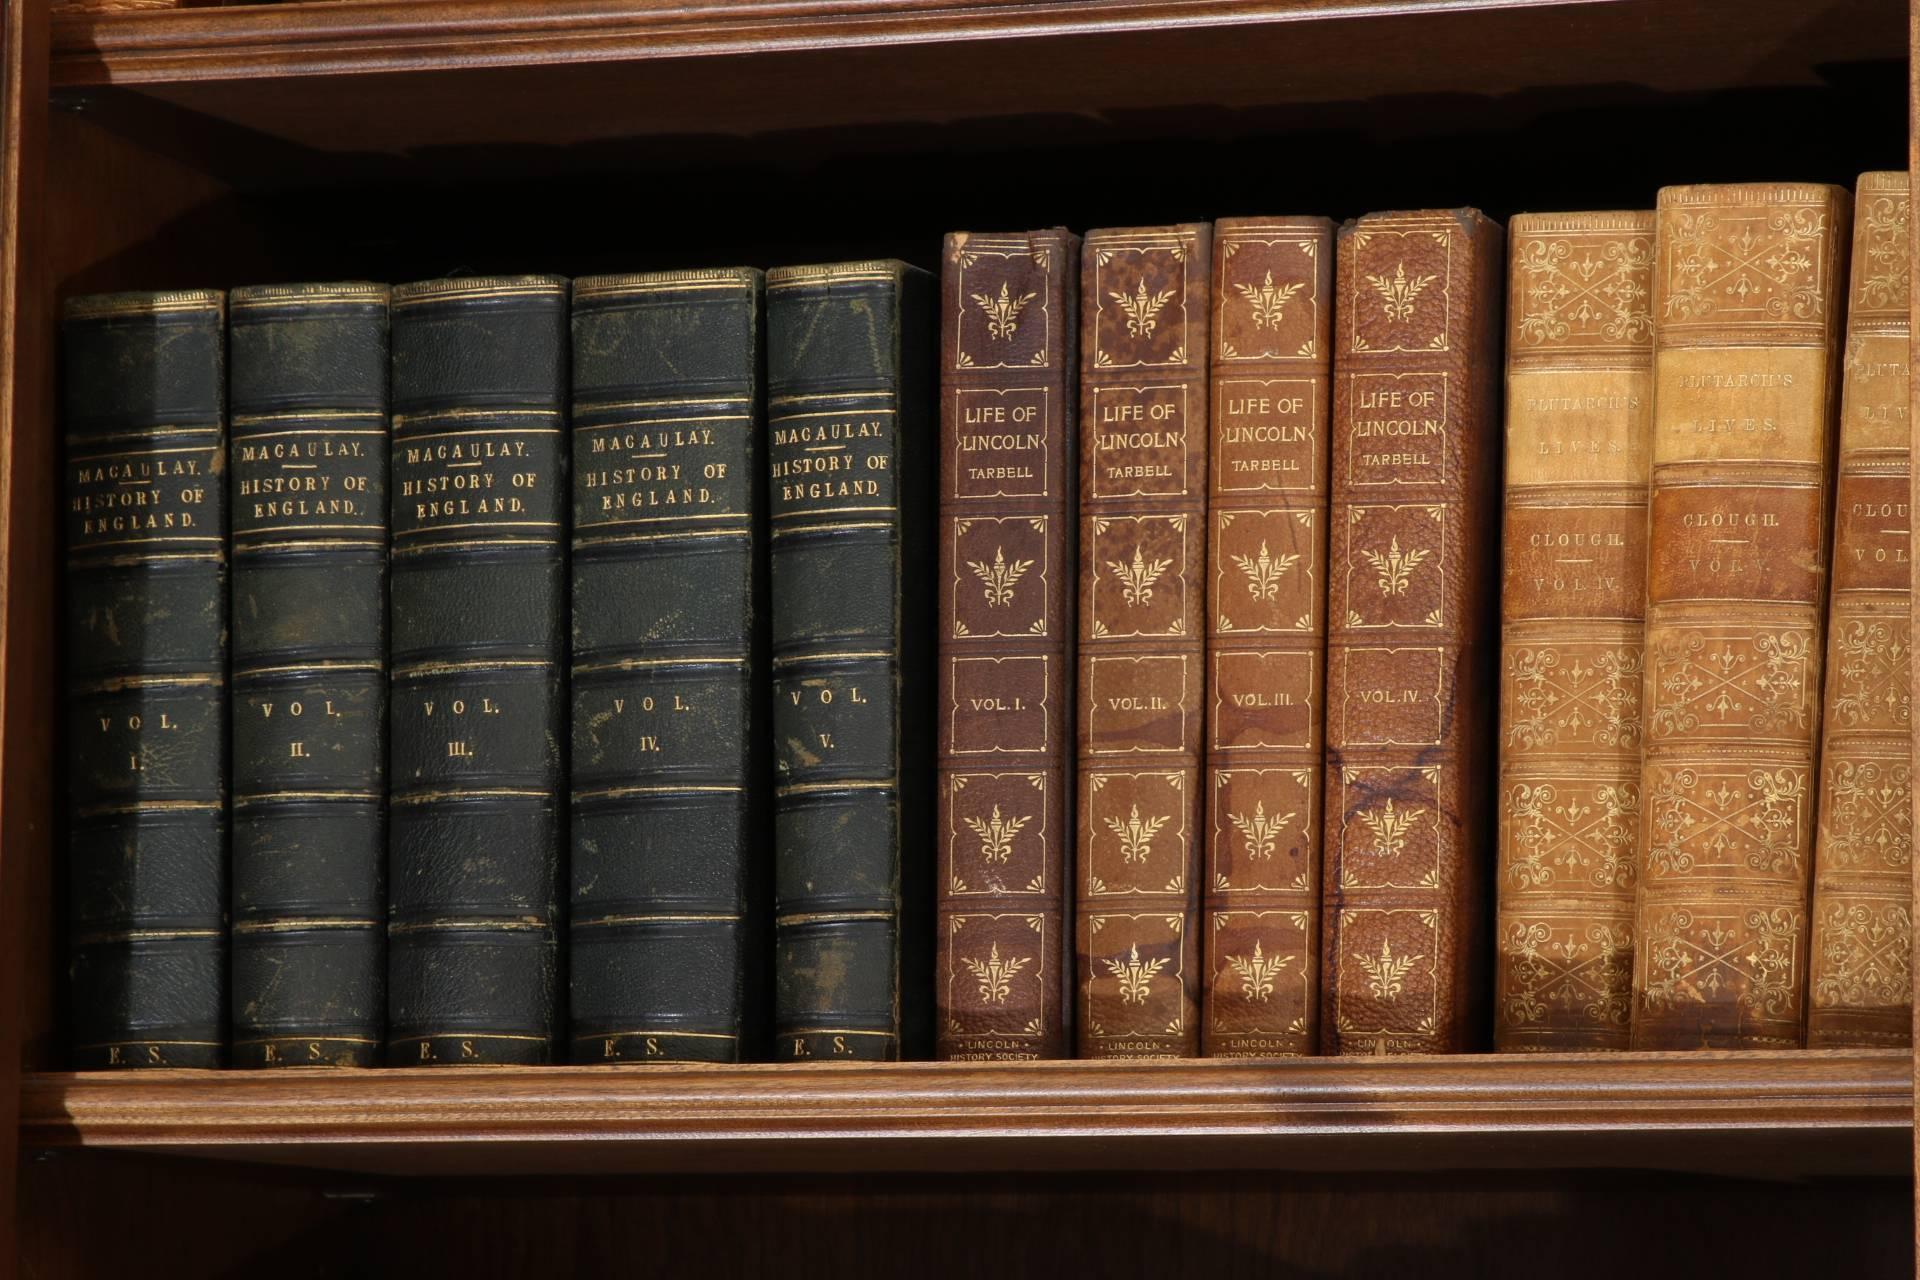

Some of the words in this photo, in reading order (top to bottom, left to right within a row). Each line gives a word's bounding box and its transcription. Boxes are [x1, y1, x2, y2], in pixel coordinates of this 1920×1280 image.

[1229, 399, 1270, 415] LIFE
[1277, 398, 1303, 414] OF
[1359, 391, 1401, 409] LIFE
[1408, 392, 1434, 407] OF
[966, 407, 1005, 423] LIFE
[1012, 406, 1037, 422] OF
[1103, 405, 1143, 422] LIFE
[1150, 404, 1176, 420] OF
[775, 422, 883, 445] MACAULAY.
[1356, 420, 1437, 436] LINCOLN
[1693, 418, 1777, 432] LIVES.
[592, 430, 714, 452] MACAULAY.
[962, 434, 1040, 451] LINCOLN
[1100, 431, 1179, 450] LINCOLN
[1226, 426, 1306, 443] LINCOLN
[242, 441, 364, 461] MACAULAY.
[407, 441, 530, 463] MACAULAY.
[1539, 440, 1621, 455] LIVES.
[772, 455, 852, 478] HISTORY
[867, 455, 888, 470] OF
[1231, 460, 1299, 472] TARBELL
[1362, 454, 1430, 466] TARBELL
[79, 460, 201, 483] MACAULAY.
[587, 465, 680, 487] HISTORY
[704, 463, 727, 479] OF
[968, 467, 1033, 479] TARBELL
[1106, 465, 1172, 478] TARBELL
[241, 476, 330, 495] HISTORY
[344, 476, 367, 491] OF
[403, 473, 493, 496] HISTORY
[513, 473, 536, 488] OF
[783, 480, 880, 501] ENGLAND.
[73, 489, 161, 511] HISTORY
[182, 488, 205, 503] OF
[602, 488, 715, 510] ENGLAND.
[417, 497, 525, 519] ENGLAND.
[1853, 503, 1909, 518] CLOU
[84, 512, 196, 535] ENGLAND.
[1683, 513, 1779, 527] CLOUGH.
[1530, 533, 1624, 546] CLOUGH.
[1855, 549, 1909, 563] VOL
[1535, 578, 1586, 591] VOL.
[1596, 577, 1619, 590] IV.
[615, 696, 690, 713] VOL.
[791, 687, 867, 706] VOL.
[263, 701, 341, 718] VOL.
[424, 698, 500, 716] VOL.
[101, 714, 177, 732] VOL.
[448, 742, 473, 757] III.
[640, 735, 660, 752] IV.
[820, 734, 834, 748] V.
[290, 743, 310, 757] II.
[131, 755, 145, 770] I.
[264, 1045, 282, 1062] E.
[309, 1042, 329, 1061] S.
[420, 1042, 437, 1059] E.
[462, 1040, 479, 1058] S.
[604, 1039, 621, 1057] E.
[647, 1037, 665, 1055] S.
[795, 1039, 811, 1056] E.
[833, 1036, 852, 1054] S.
[968, 1040, 1019, 1049] LINCOLN
[1109, 1042, 1160, 1050] LINCOLN
[1232, 1039, 1283, 1048] LINCOLN
[1357, 1039, 1411, 1048] LINOLN
[109, 1047, 126, 1064] E.
[148, 1046, 167, 1063] S.
[950, 1053, 992, 1061] HISTORY
